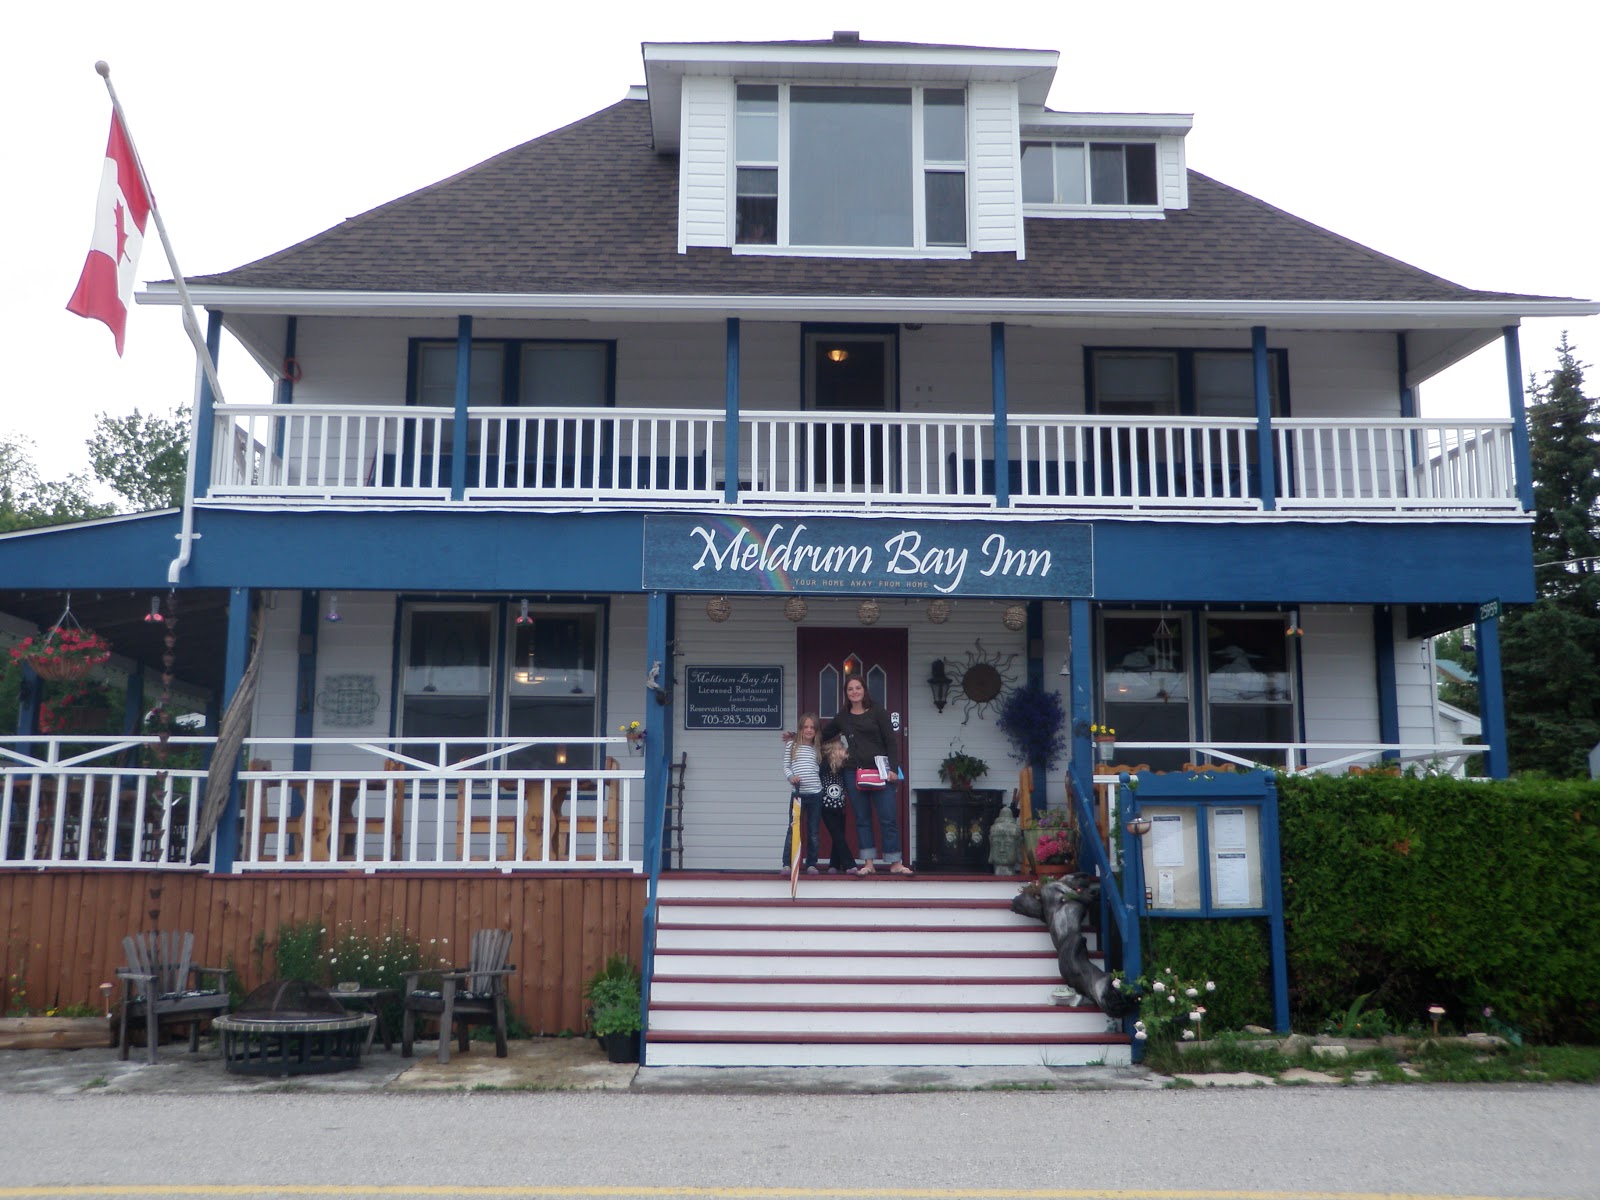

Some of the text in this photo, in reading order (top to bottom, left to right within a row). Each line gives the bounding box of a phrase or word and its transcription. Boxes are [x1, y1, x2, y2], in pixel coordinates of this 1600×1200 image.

[690, 523, 1051, 593] Meldrum Bay Inn
[794, 578, 817, 586] YOUR
[822, 579, 844, 587] HOME
[850, 580, 873, 588] AWAY
[878, 580, 901, 588] FROM
[690, 671, 779, 687] Meldrum Bay Inn
[698, 686, 774, 694] Licensed Restaurant
[689, 704, 778, 713] Reservations Recommended
[701, 714, 767, 725] 705-283-3190
